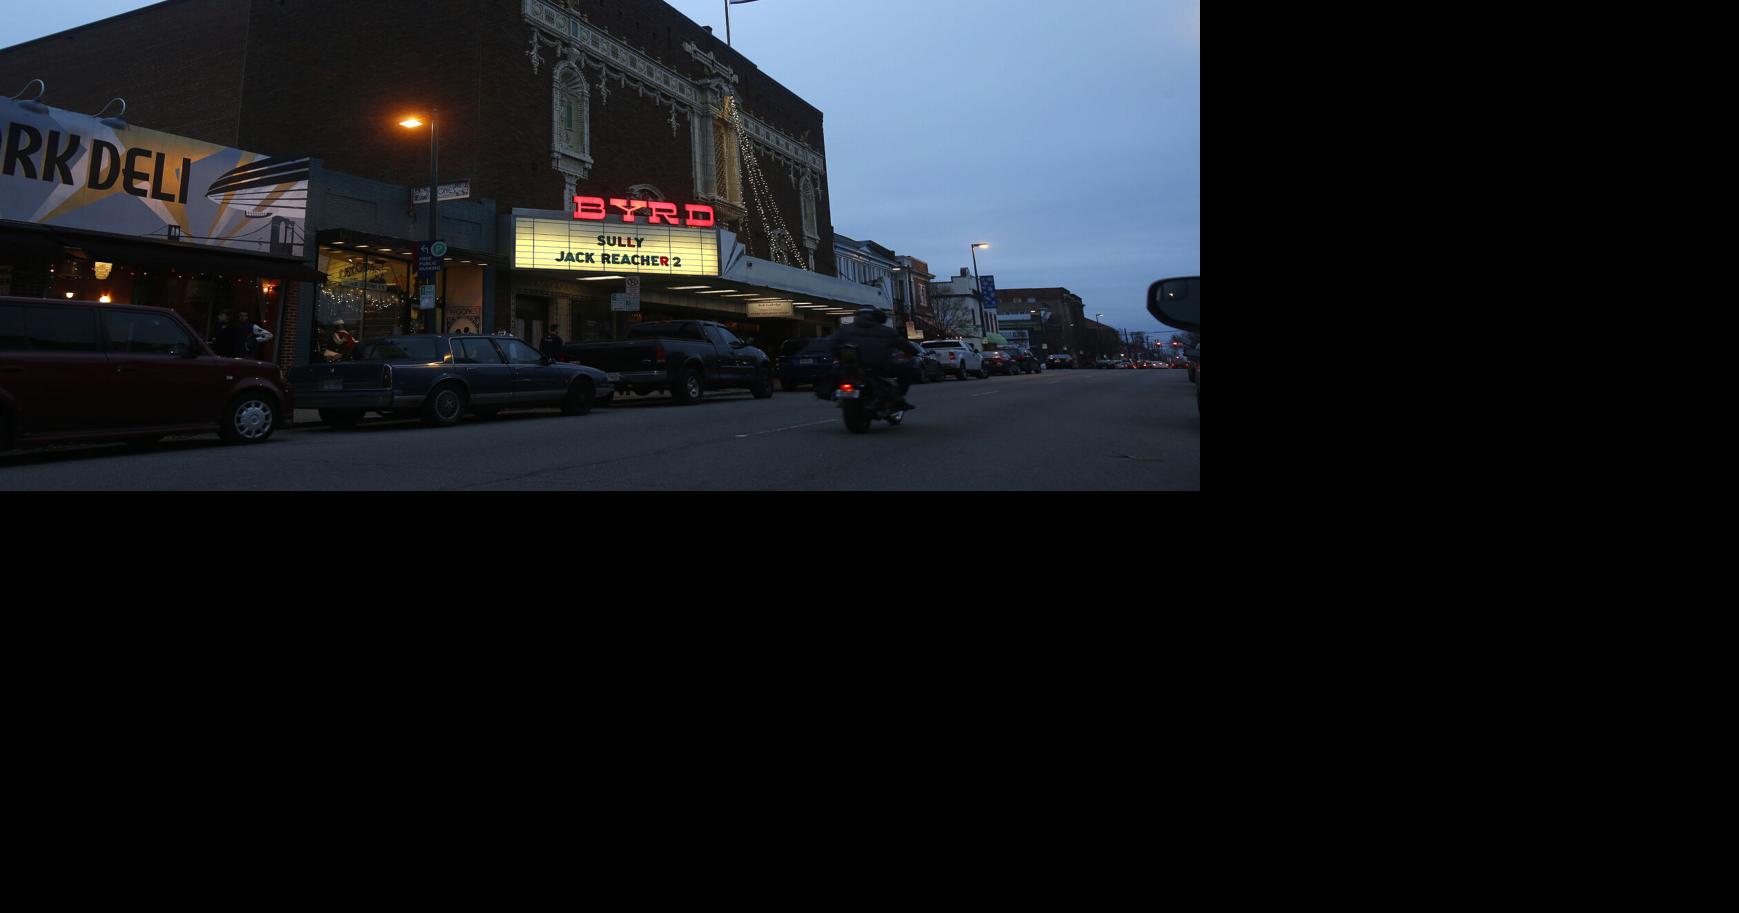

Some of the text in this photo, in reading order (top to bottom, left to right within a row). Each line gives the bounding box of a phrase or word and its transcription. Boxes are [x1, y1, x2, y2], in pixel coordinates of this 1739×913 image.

[0, 122, 191, 205] RK DELI
[573, 195, 715, 227] BYRD
[597, 235, 644, 248] SULLY
[555, 251, 682, 267] JACK REACHER 2
